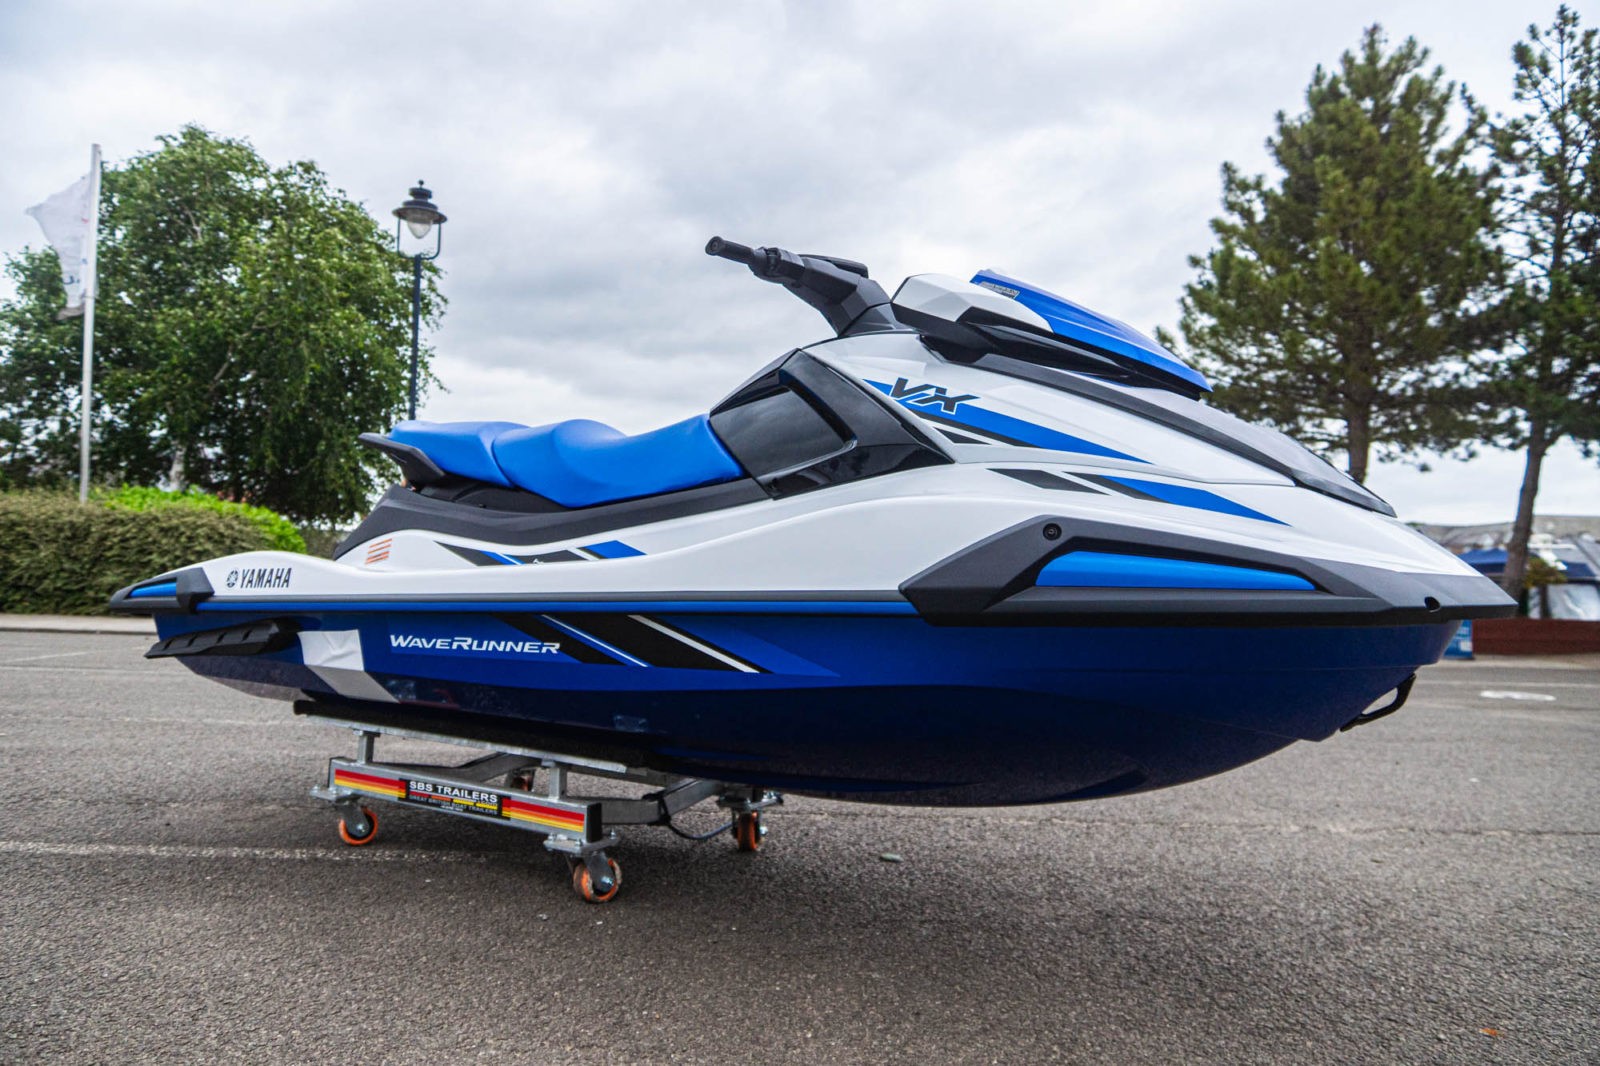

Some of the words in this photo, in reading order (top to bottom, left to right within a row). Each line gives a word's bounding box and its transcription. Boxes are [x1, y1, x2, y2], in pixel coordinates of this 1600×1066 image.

[890, 377, 981, 414] VX
[240, 568, 292, 589] YAMAHA
[409, 780, 433, 792] SBS
[436, 785, 498, 803] TRAILERS
